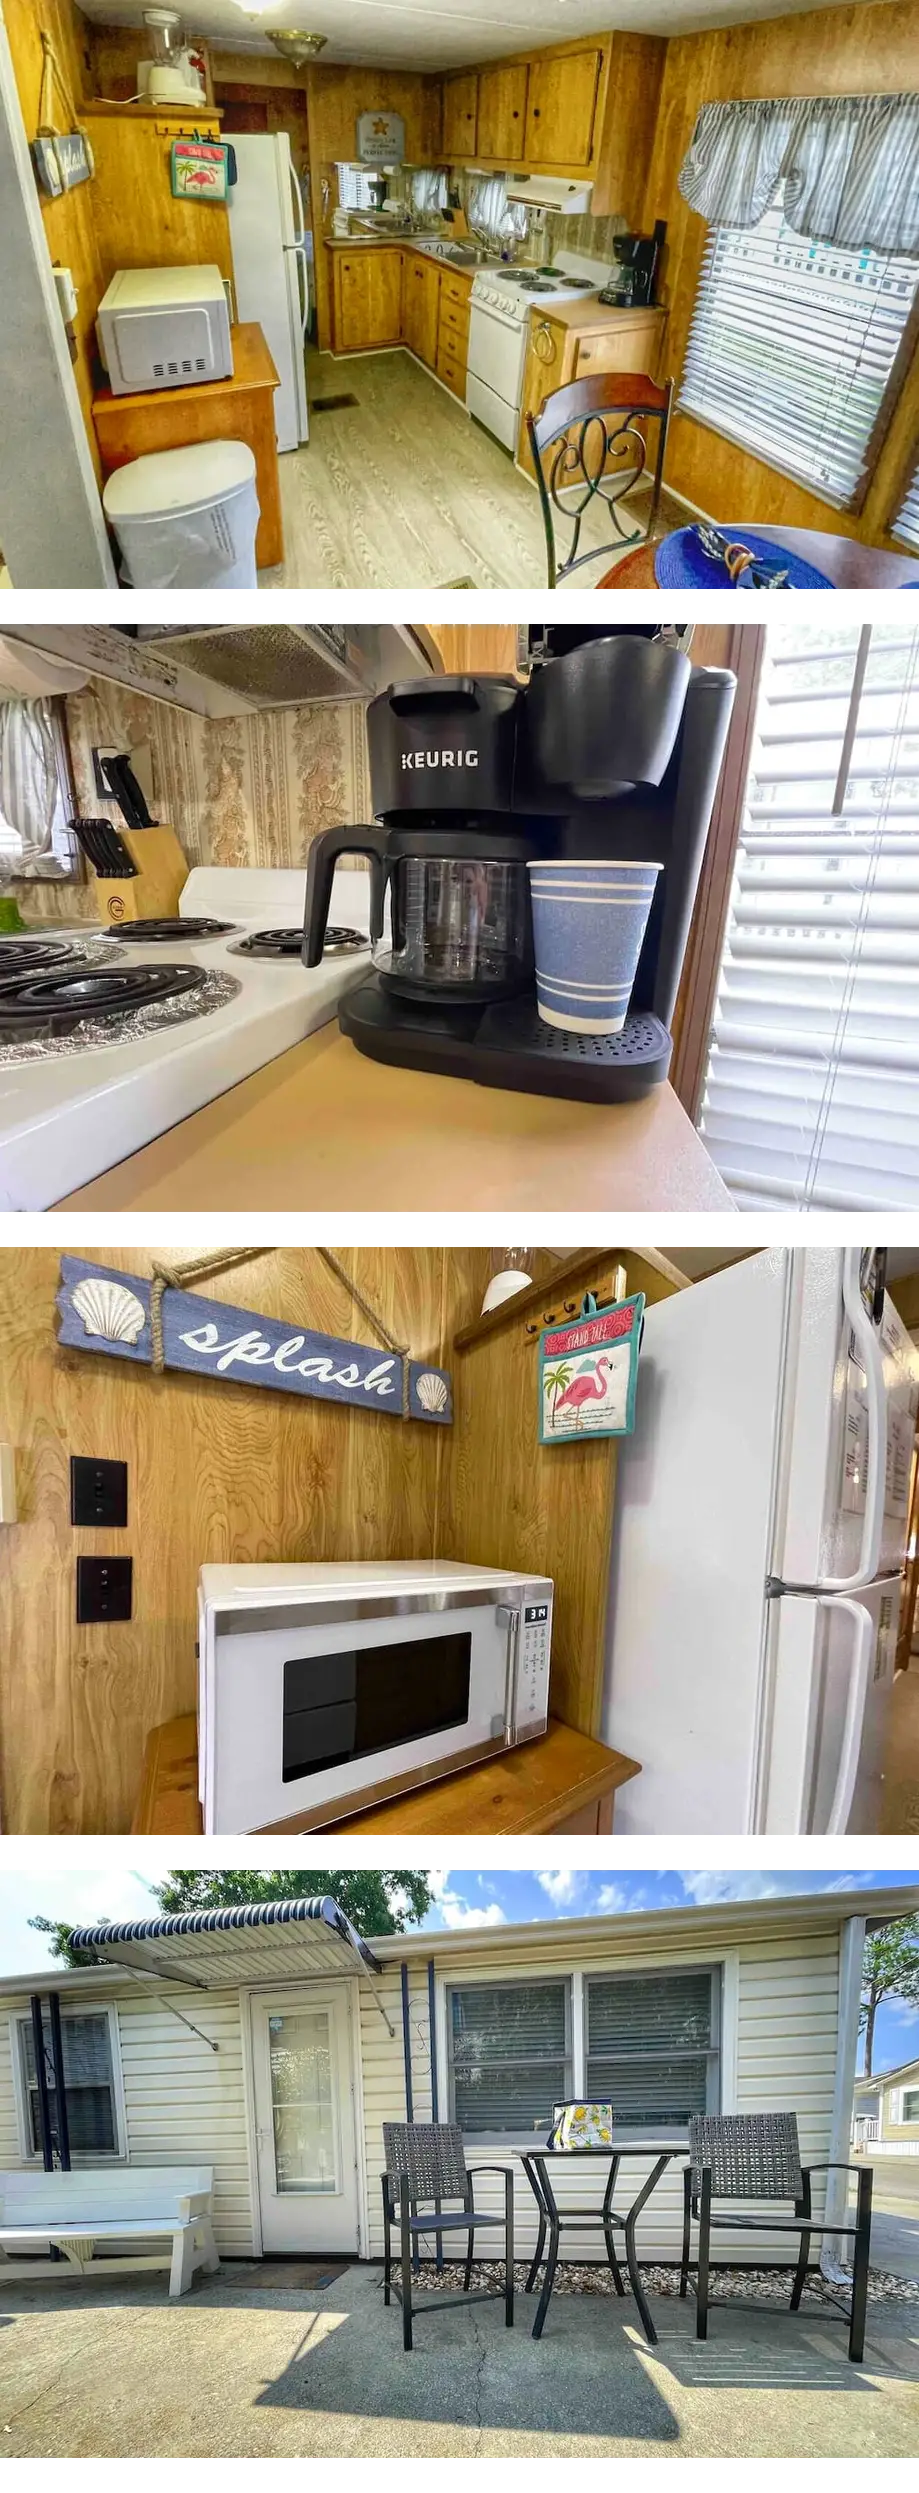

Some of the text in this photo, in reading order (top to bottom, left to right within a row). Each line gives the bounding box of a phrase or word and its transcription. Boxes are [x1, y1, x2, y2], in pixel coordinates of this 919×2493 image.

[401, 750, 479, 770] KEURIG
[567, 1330, 589, 1350] STAND
[178, 1323, 396, 1396] splash
